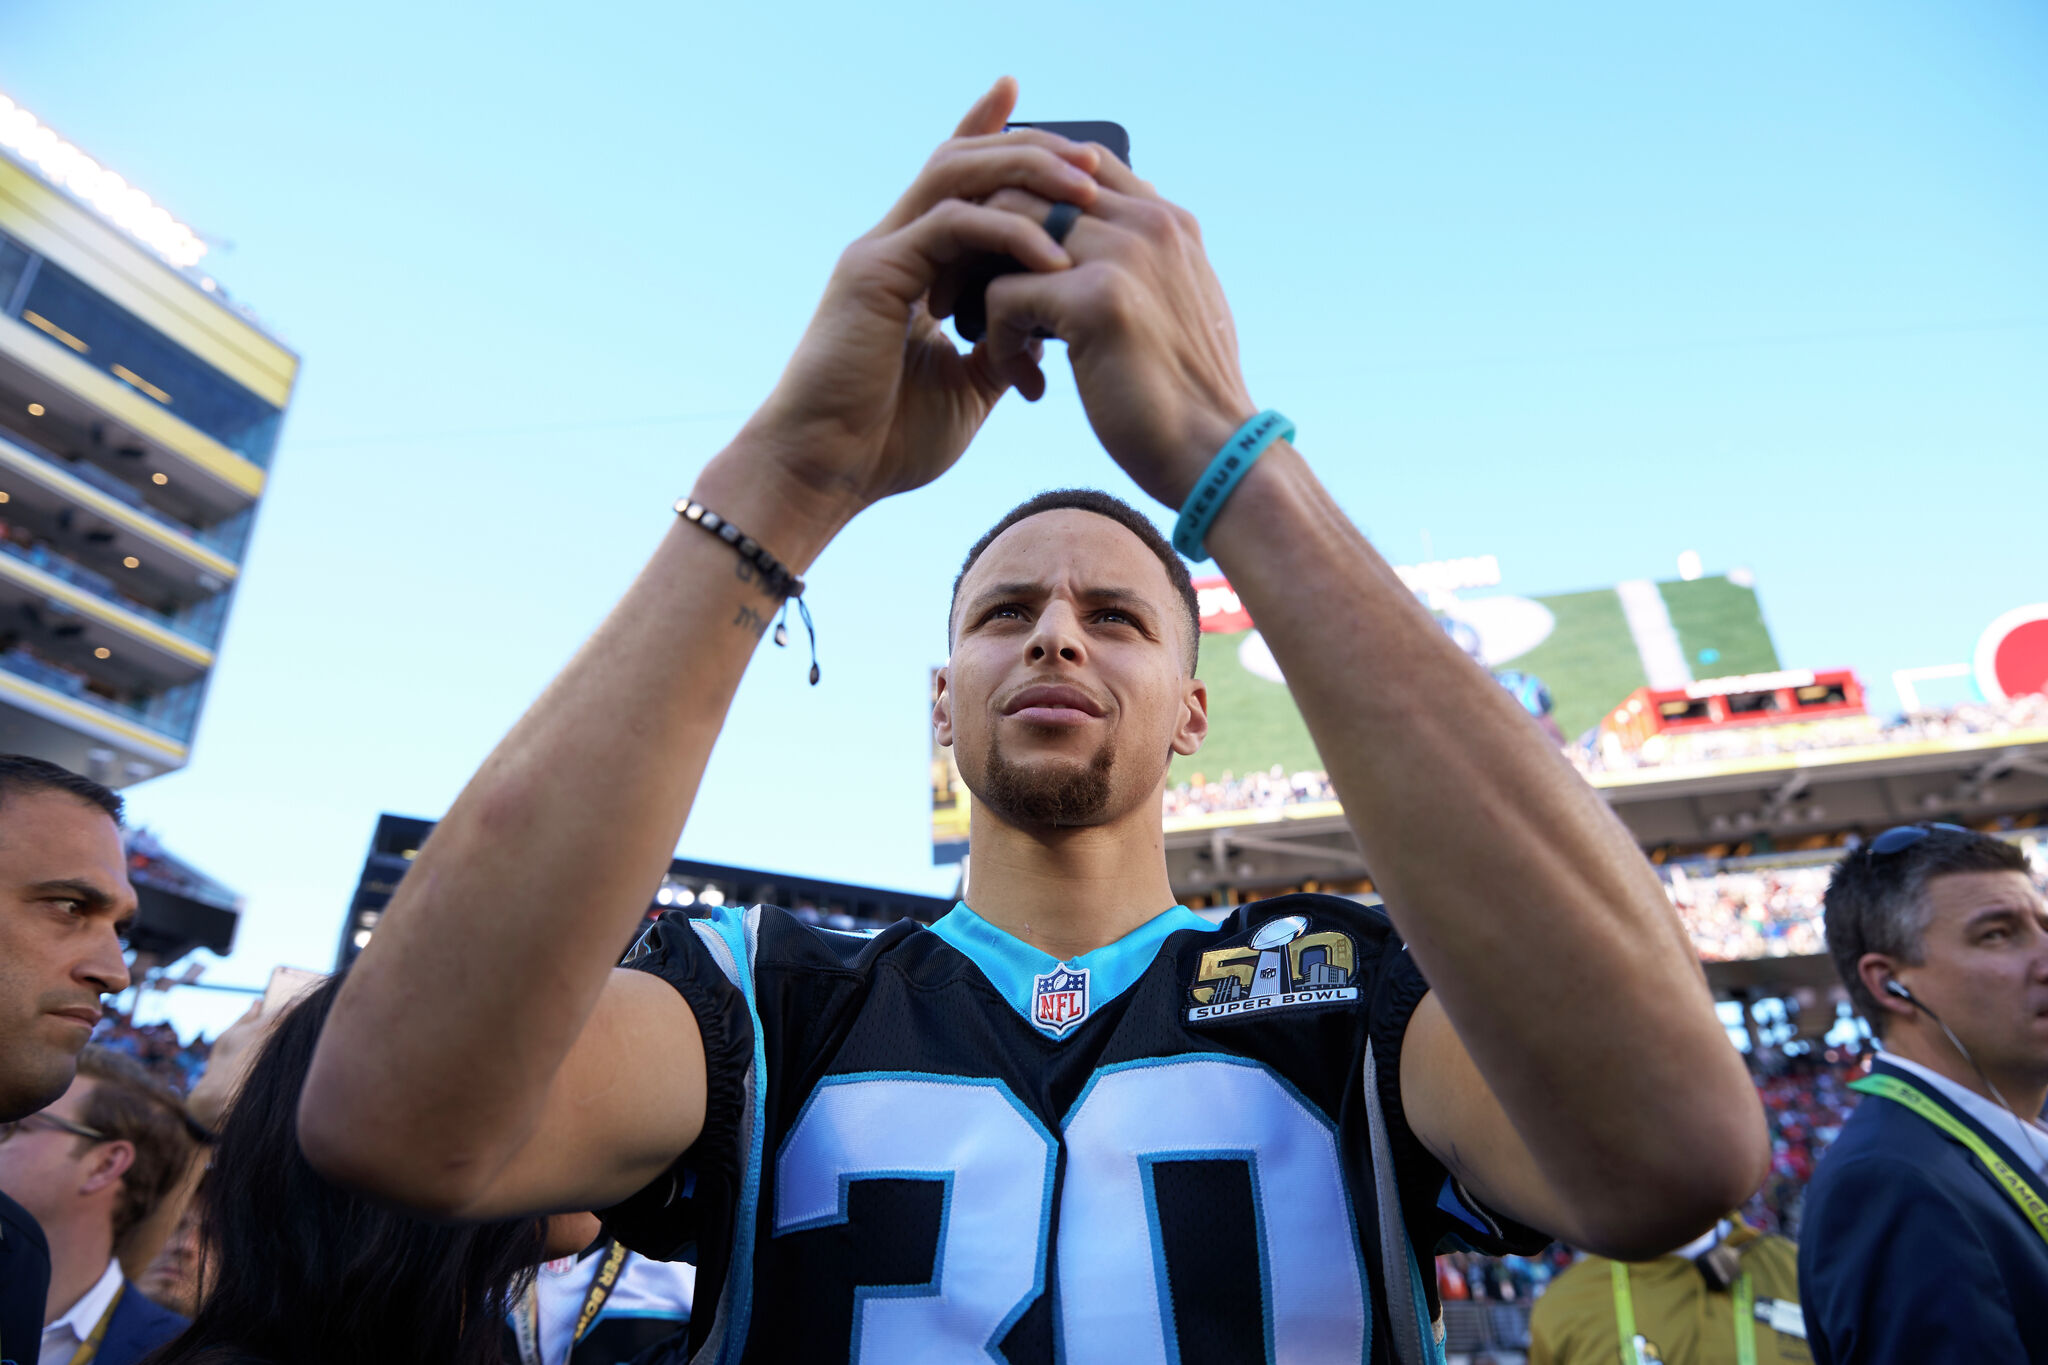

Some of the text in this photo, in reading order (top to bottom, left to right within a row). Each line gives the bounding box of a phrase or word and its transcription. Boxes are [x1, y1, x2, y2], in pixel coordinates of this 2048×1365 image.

[1187, 456, 1240, 529] JESUS
[1040, 991, 1081, 1022] NFL
[1196, 988, 1349, 1018] SUPER BOWL
[773, 1051, 1372, 1365] 30
